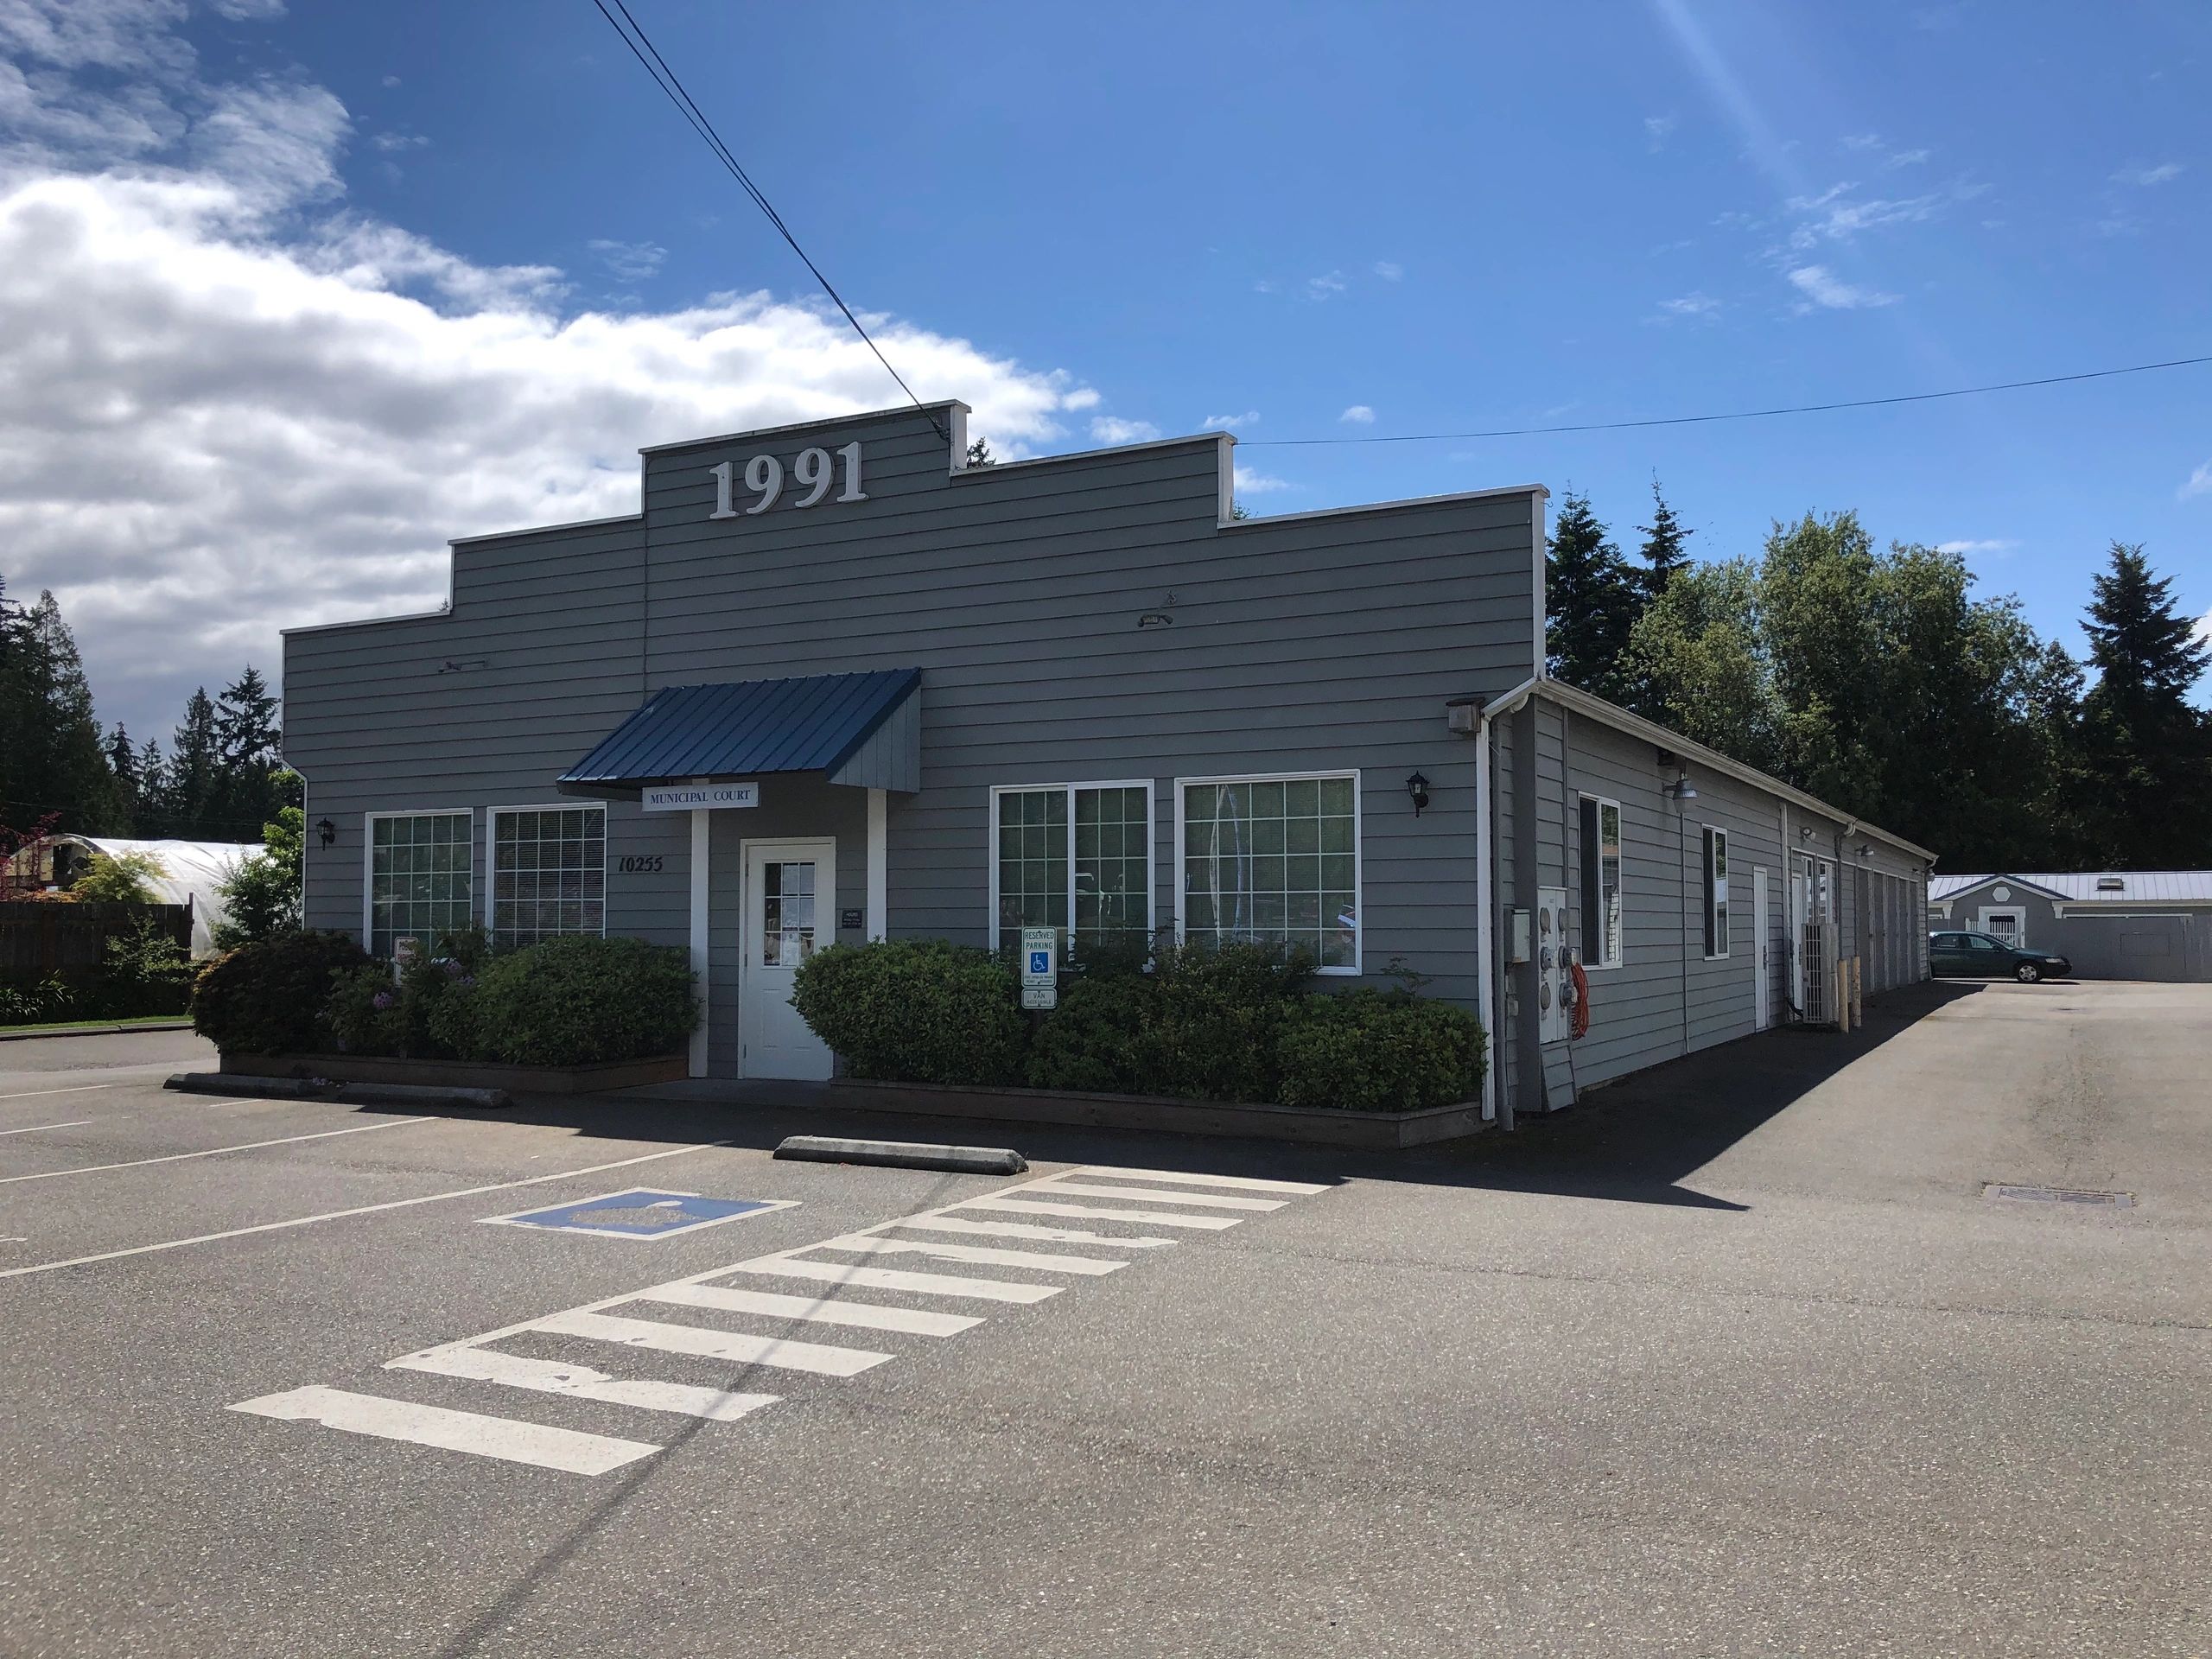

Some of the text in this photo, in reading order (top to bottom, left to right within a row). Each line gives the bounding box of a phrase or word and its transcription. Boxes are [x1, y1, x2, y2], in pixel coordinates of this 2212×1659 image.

[709, 441, 869, 520] 1991
[651, 790, 750, 804] MUNICIPAL COURT
[619, 856, 664, 873] 10255
